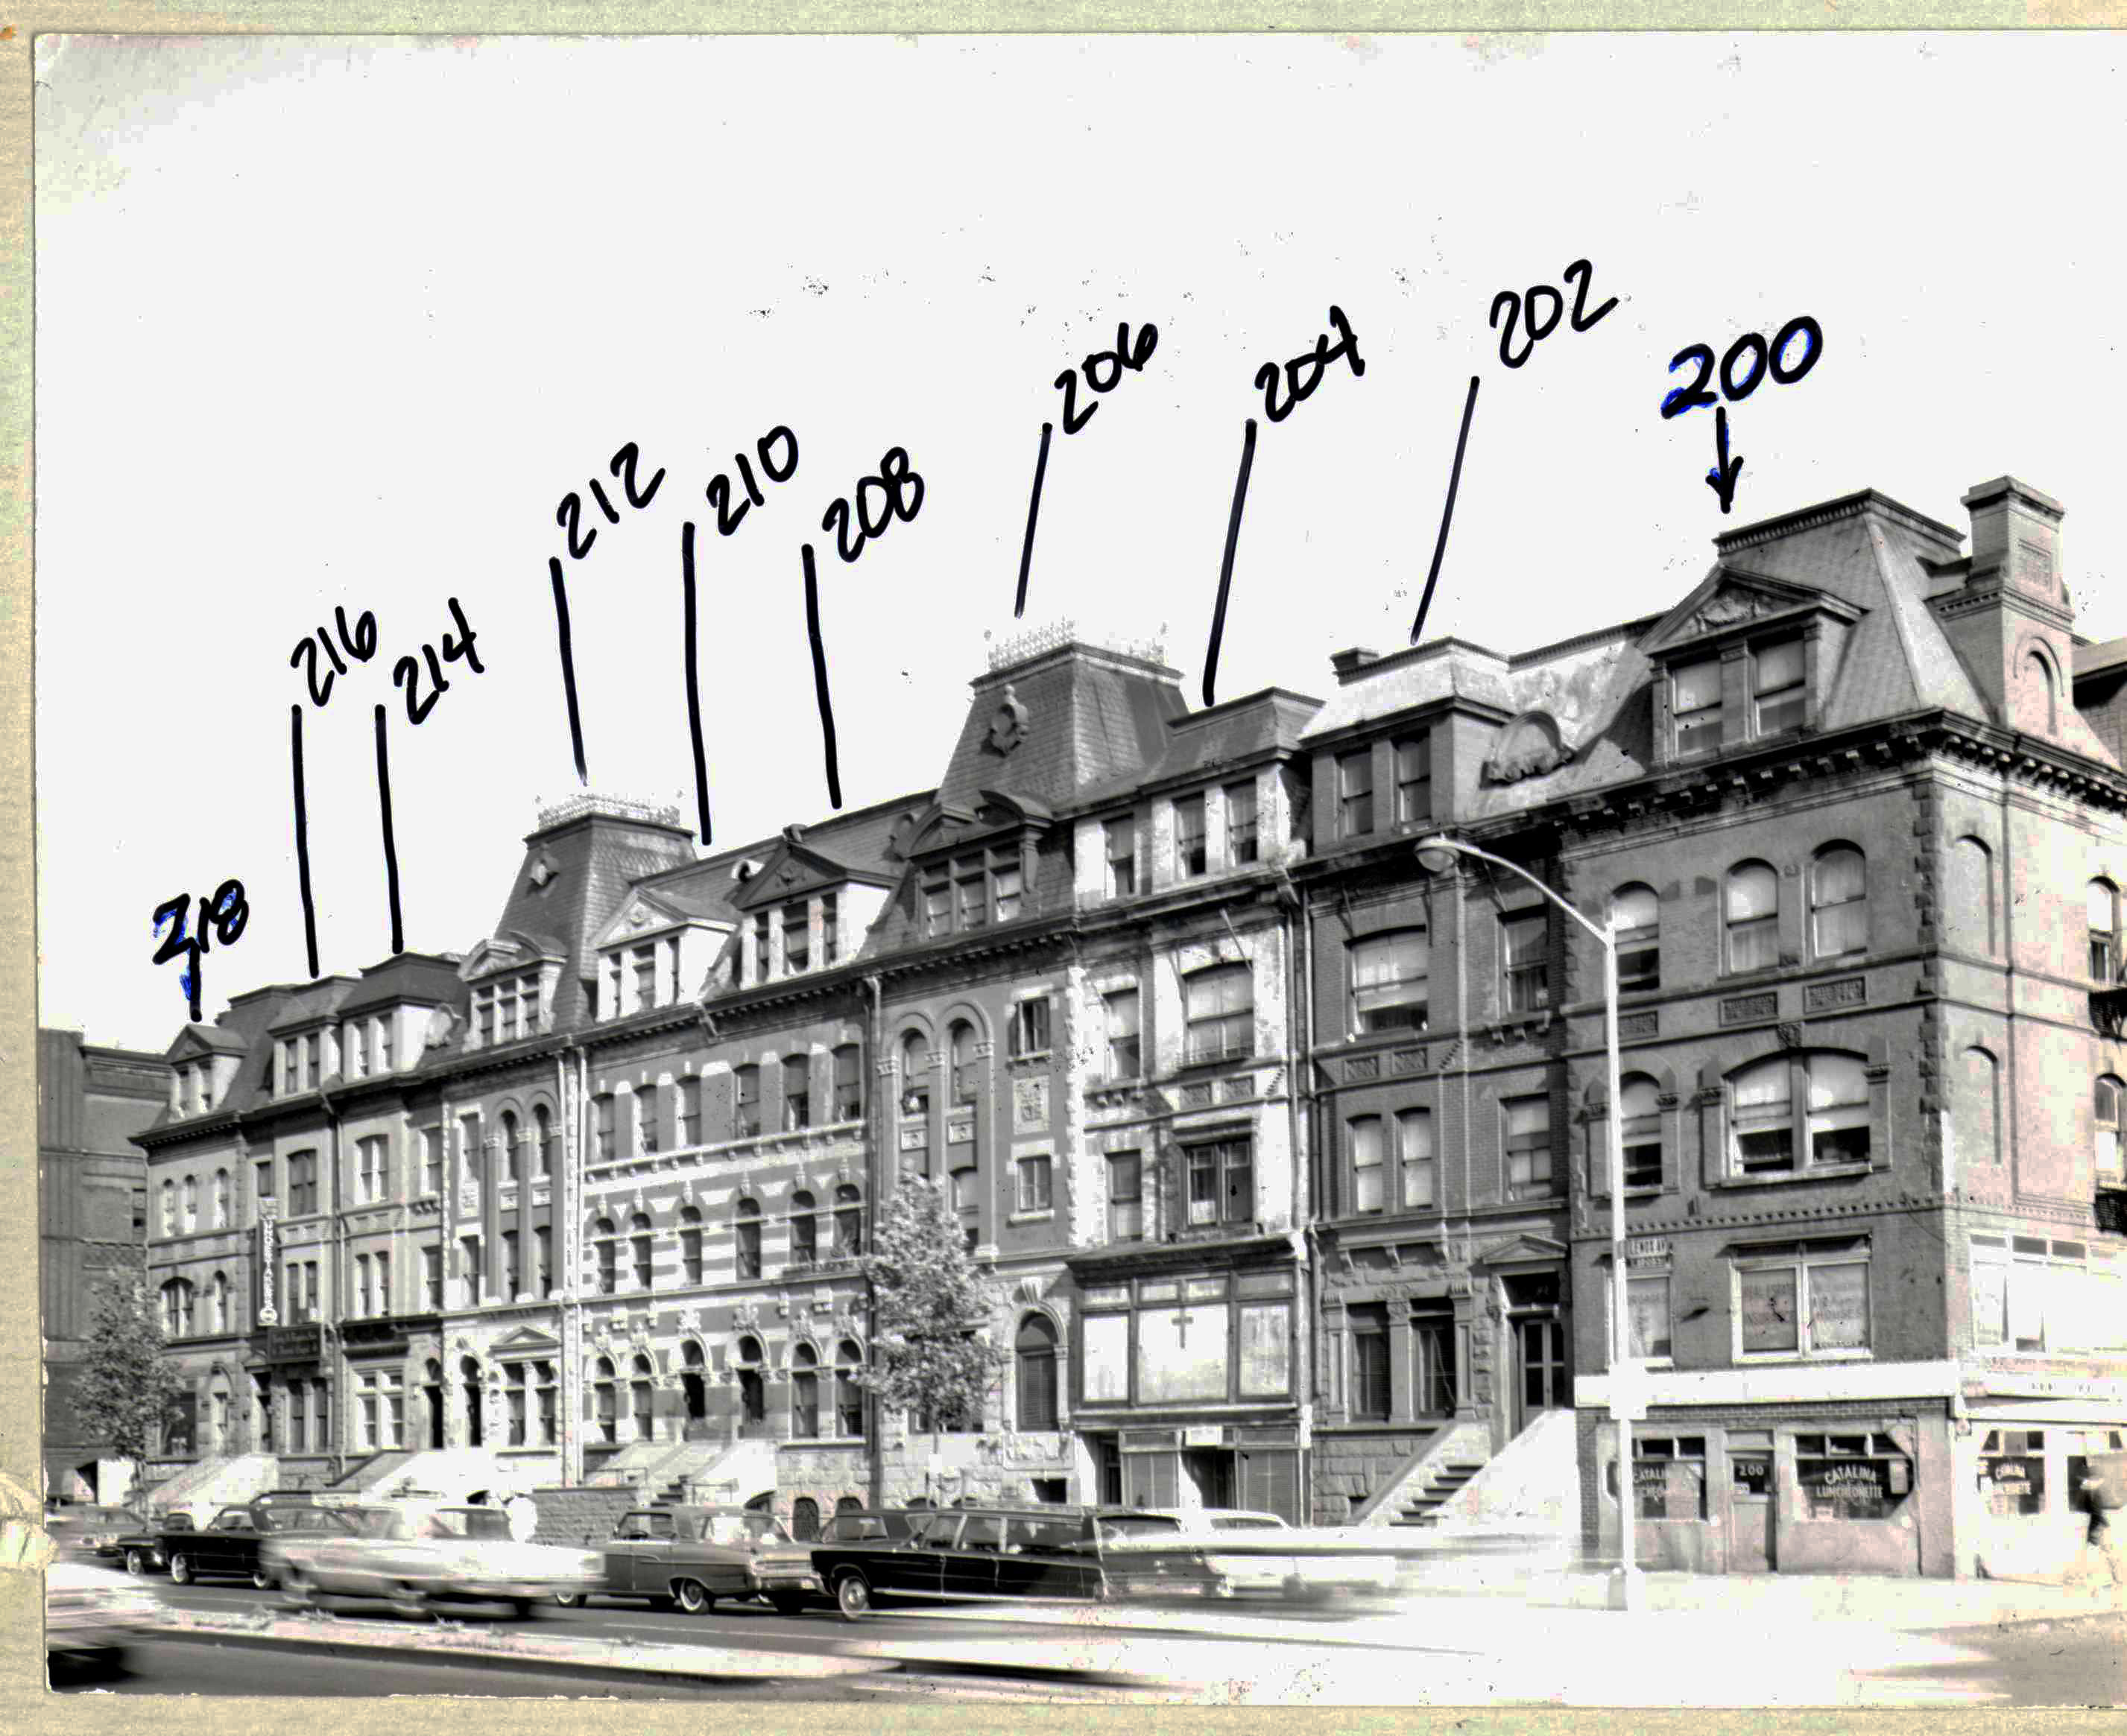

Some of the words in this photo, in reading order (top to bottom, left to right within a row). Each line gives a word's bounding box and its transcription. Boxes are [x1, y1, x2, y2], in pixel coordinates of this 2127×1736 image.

[1254, 305, 1366, 423] 204
[1489, 259, 1619, 369] 202
[1659, 315, 1823, 419] 200
[1054, 322, 1158, 435] 206
[556, 441, 666, 560] 212
[706, 425, 799, 536] 210
[821, 446, 925, 563] 208
[290, 606, 377, 708] 216
[393, 597, 485, 726] 214
[153, 879, 249, 964] 218
[1739, 1464, 1765, 1477] 200
[1815, 1483, 1883, 1499] LUNCHEONETTE
[1824, 1463, 1877, 1485] CATALINA
